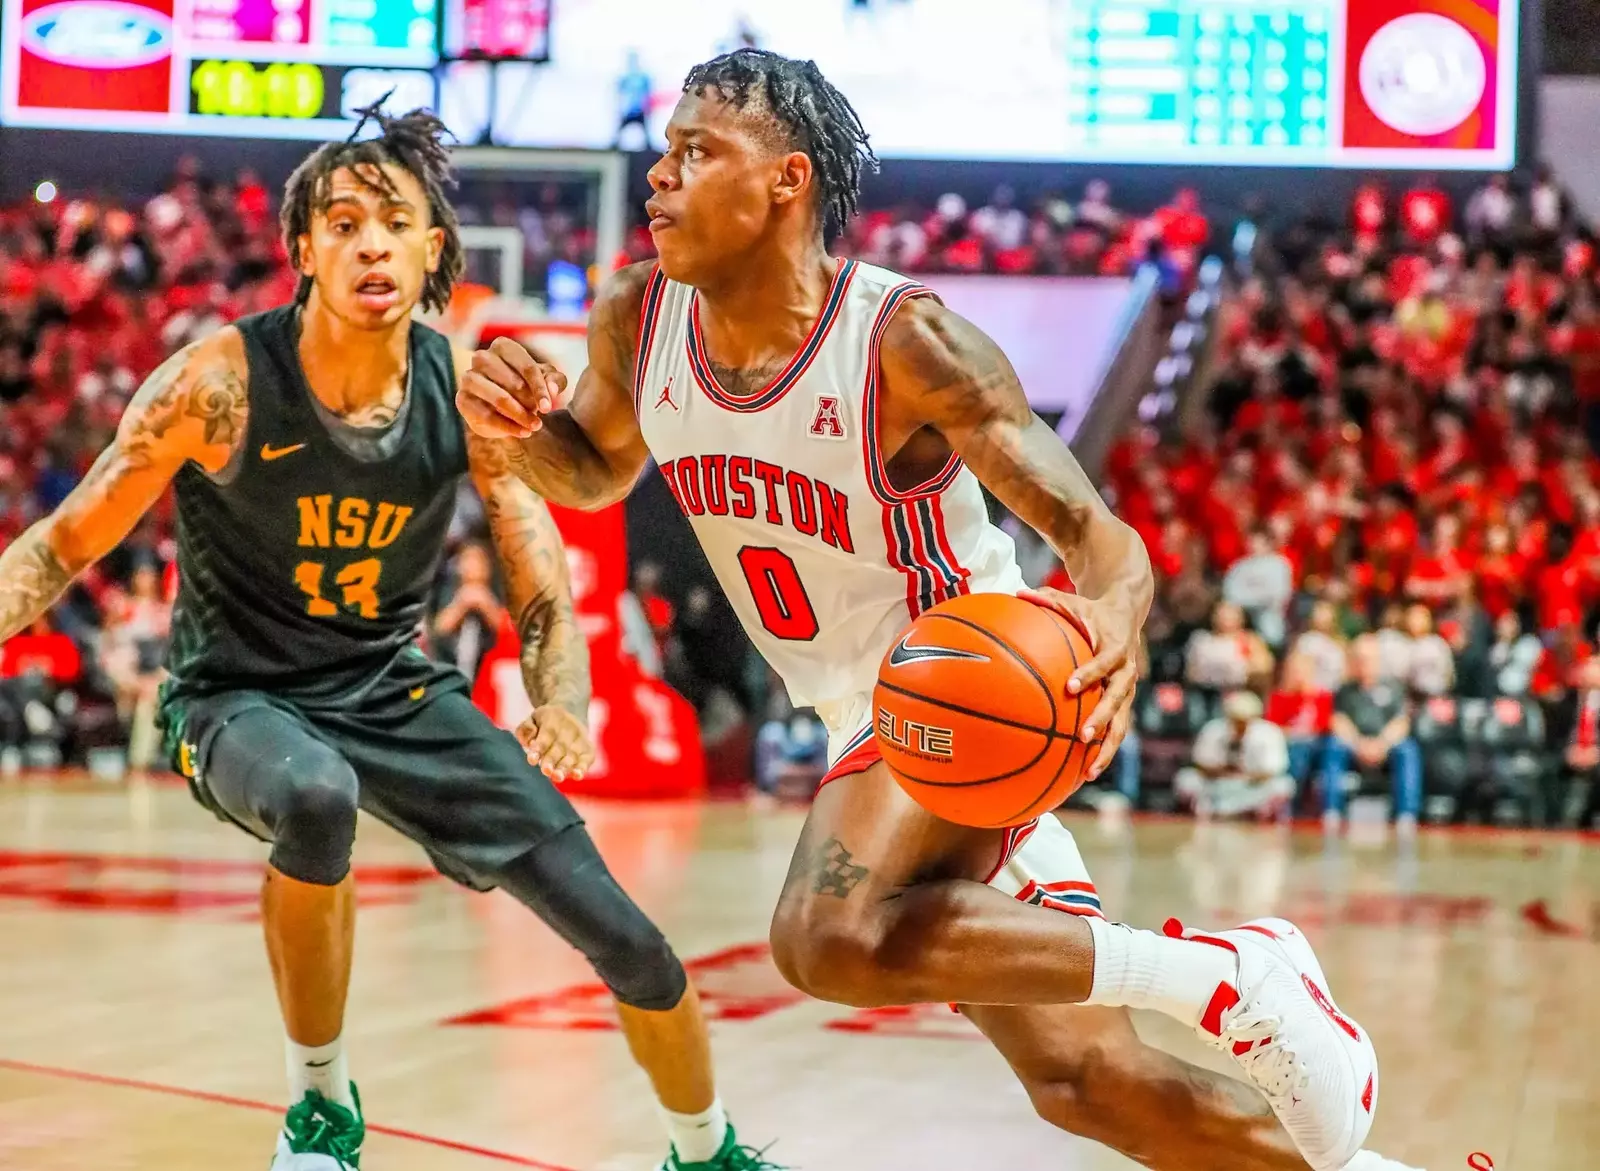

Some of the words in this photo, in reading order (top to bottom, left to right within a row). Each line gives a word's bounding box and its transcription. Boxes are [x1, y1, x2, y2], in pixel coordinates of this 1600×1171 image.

[811, 396, 843, 437] A
[297, 495, 414, 549] NSU
[294, 558, 382, 620] 13
[737, 545, 819, 641] 0
[878, 705, 953, 756] ELITE
